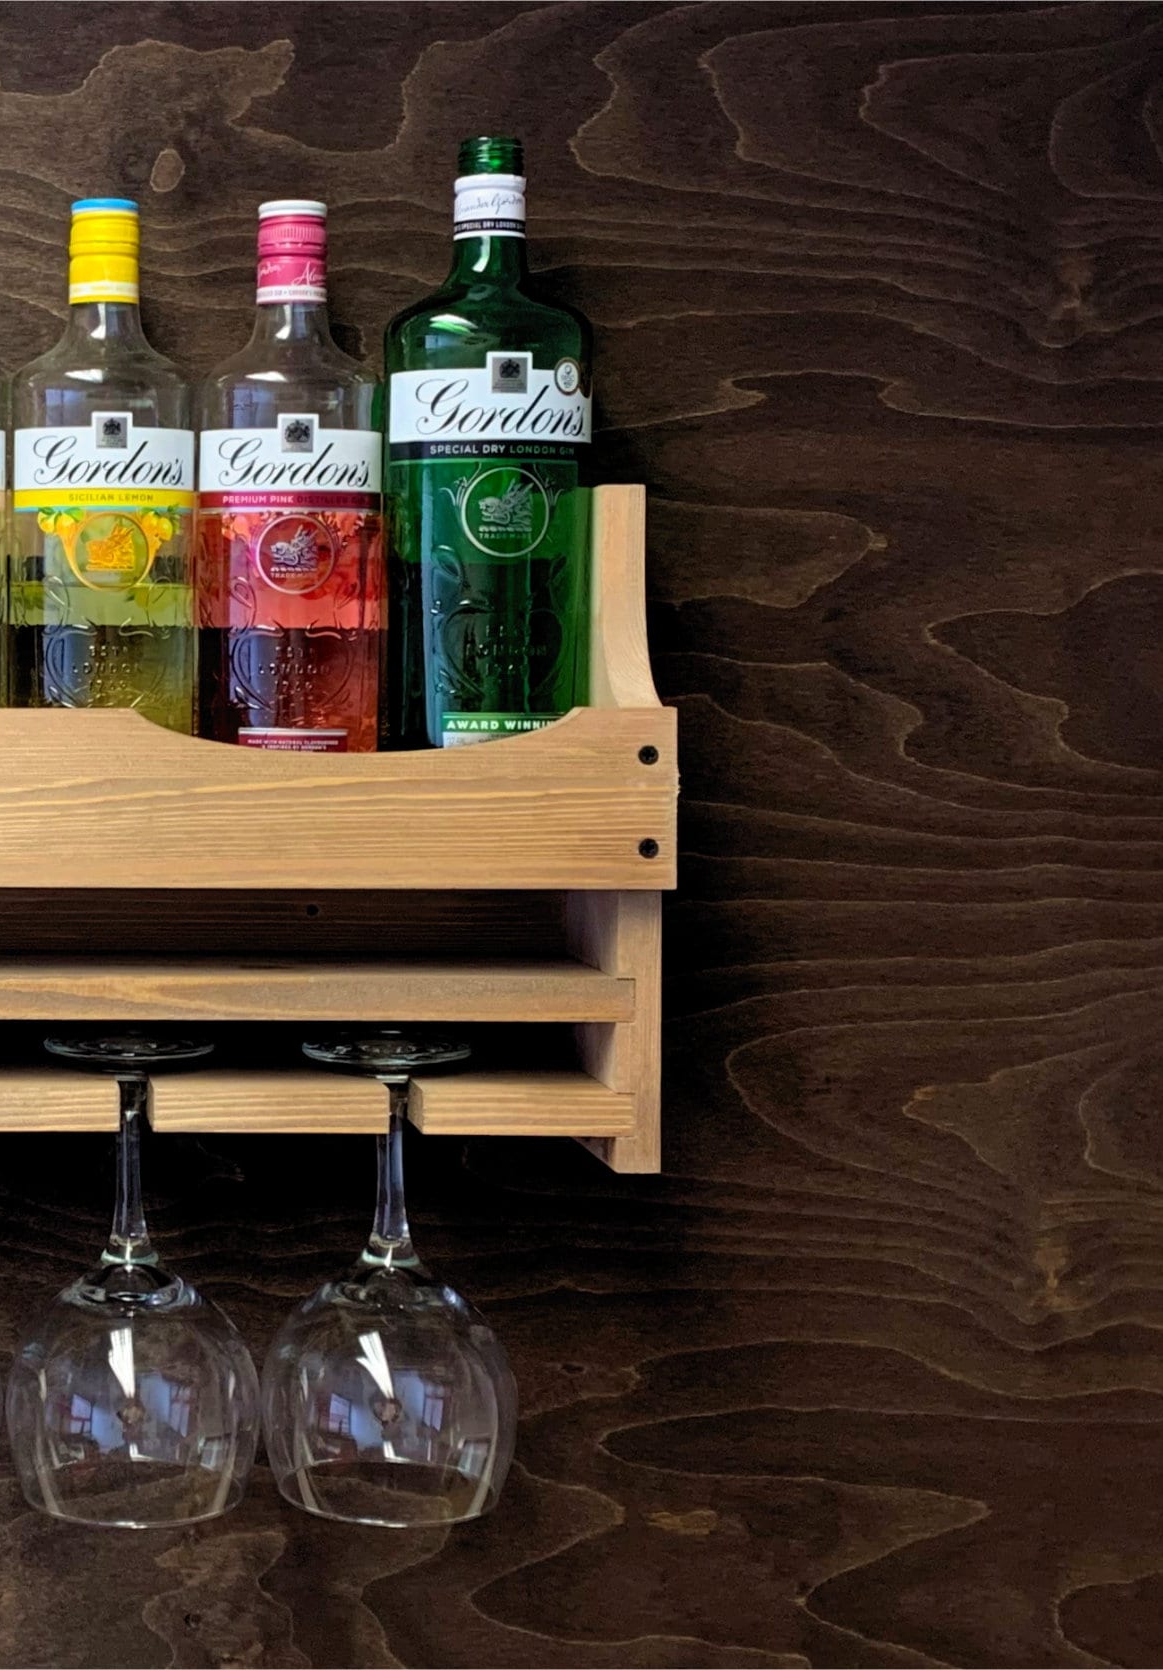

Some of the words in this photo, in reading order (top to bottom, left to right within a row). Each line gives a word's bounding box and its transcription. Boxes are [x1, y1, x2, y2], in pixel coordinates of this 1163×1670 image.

[415, 378, 584, 436] Gordon's
[430, 444, 478, 454] SPECIAL
[482, 444, 505, 454] DRY
[509, 445, 556, 454] LONDON
[559, 446, 574, 455] GIN
[33, 435, 184, 486] Gordon's
[218, 437, 370, 488] Gordon's
[69, 493, 114, 502] SICILIAN
[119, 494, 154, 502] LEMON
[222, 495, 267, 504] PREMIUM
[270, 496, 294, 504] PINK
[446, 720, 500, 730] AWARD
